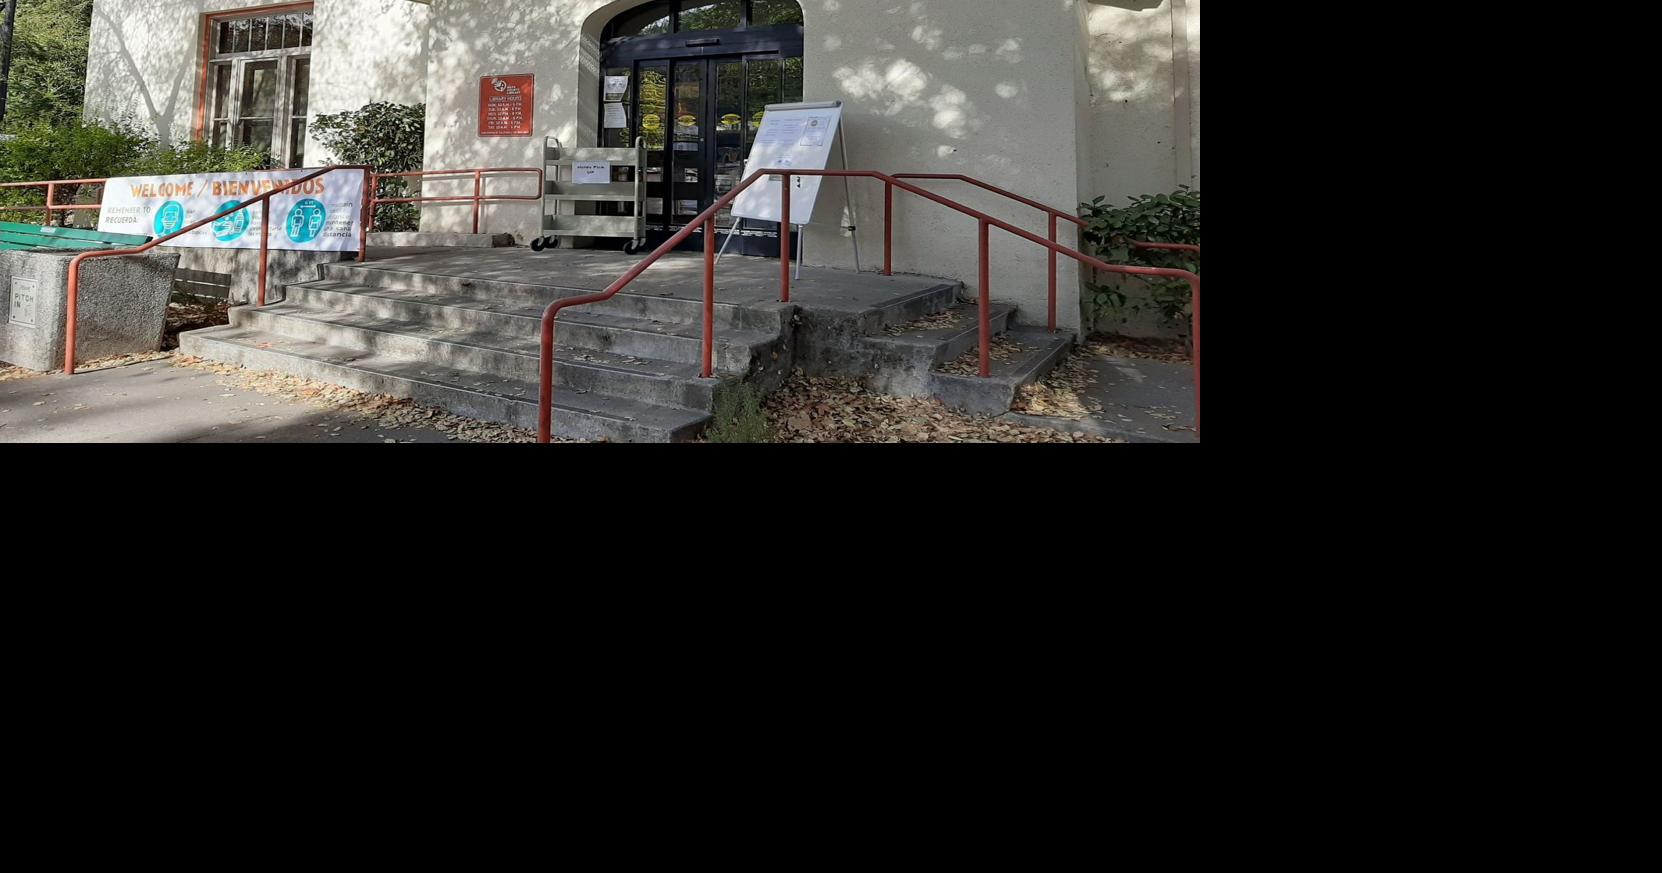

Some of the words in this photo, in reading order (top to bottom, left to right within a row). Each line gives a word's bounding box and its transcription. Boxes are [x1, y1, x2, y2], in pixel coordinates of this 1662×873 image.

[130, 181, 193, 198] WELCOME
[108, 206, 141, 214] REMEMBER
[143, 206, 151, 214] TO
[15, 293, 34, 302] PITCH
[14, 300, 21, 308] IN
